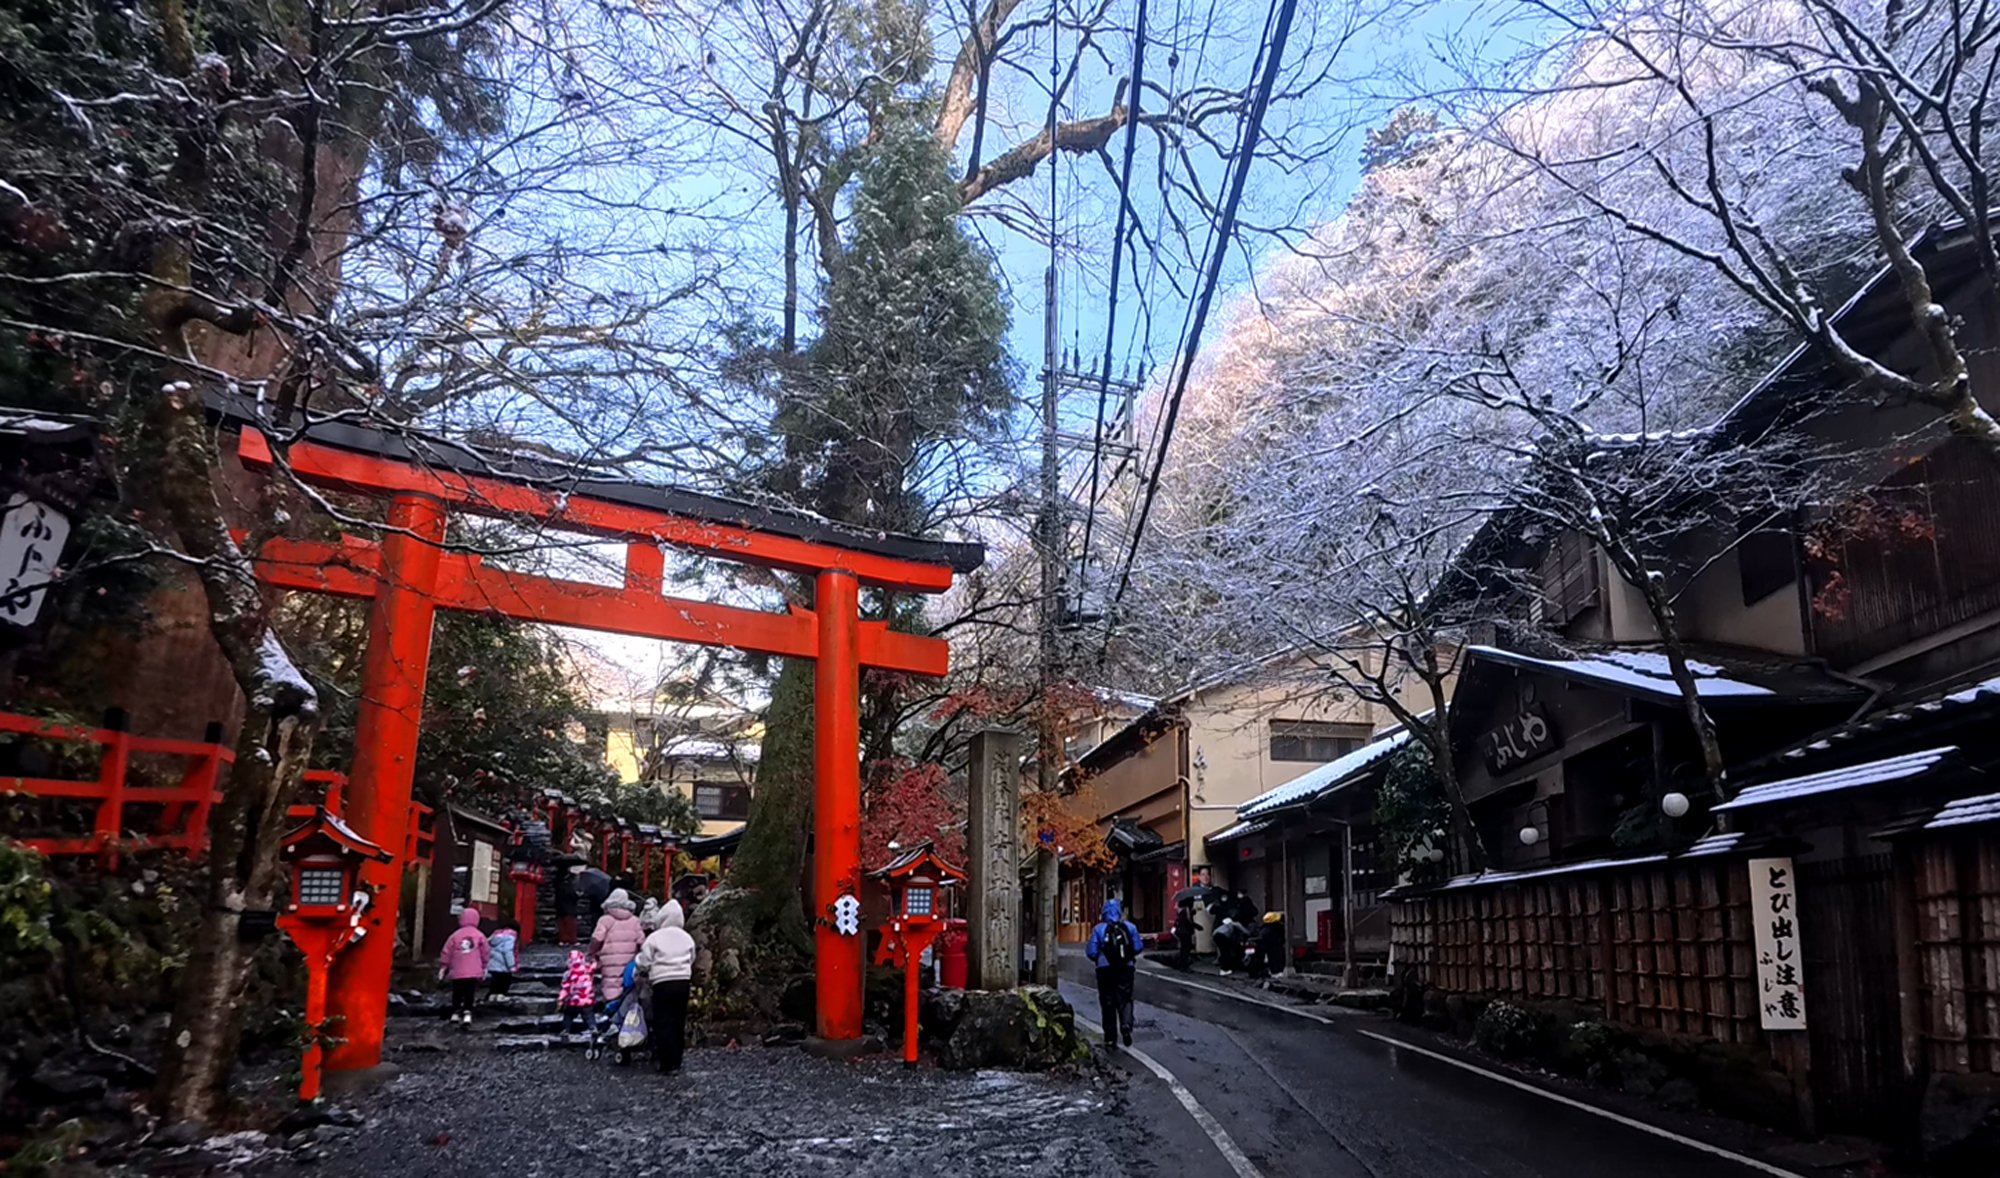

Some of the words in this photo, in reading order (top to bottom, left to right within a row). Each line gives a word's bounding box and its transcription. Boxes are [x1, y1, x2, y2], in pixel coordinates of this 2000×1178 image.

[1491, 711, 1547, 769] ふじや
[1769, 866, 1801, 1019] とび出し注意
[1759, 951, 1778, 1017] ふじや
